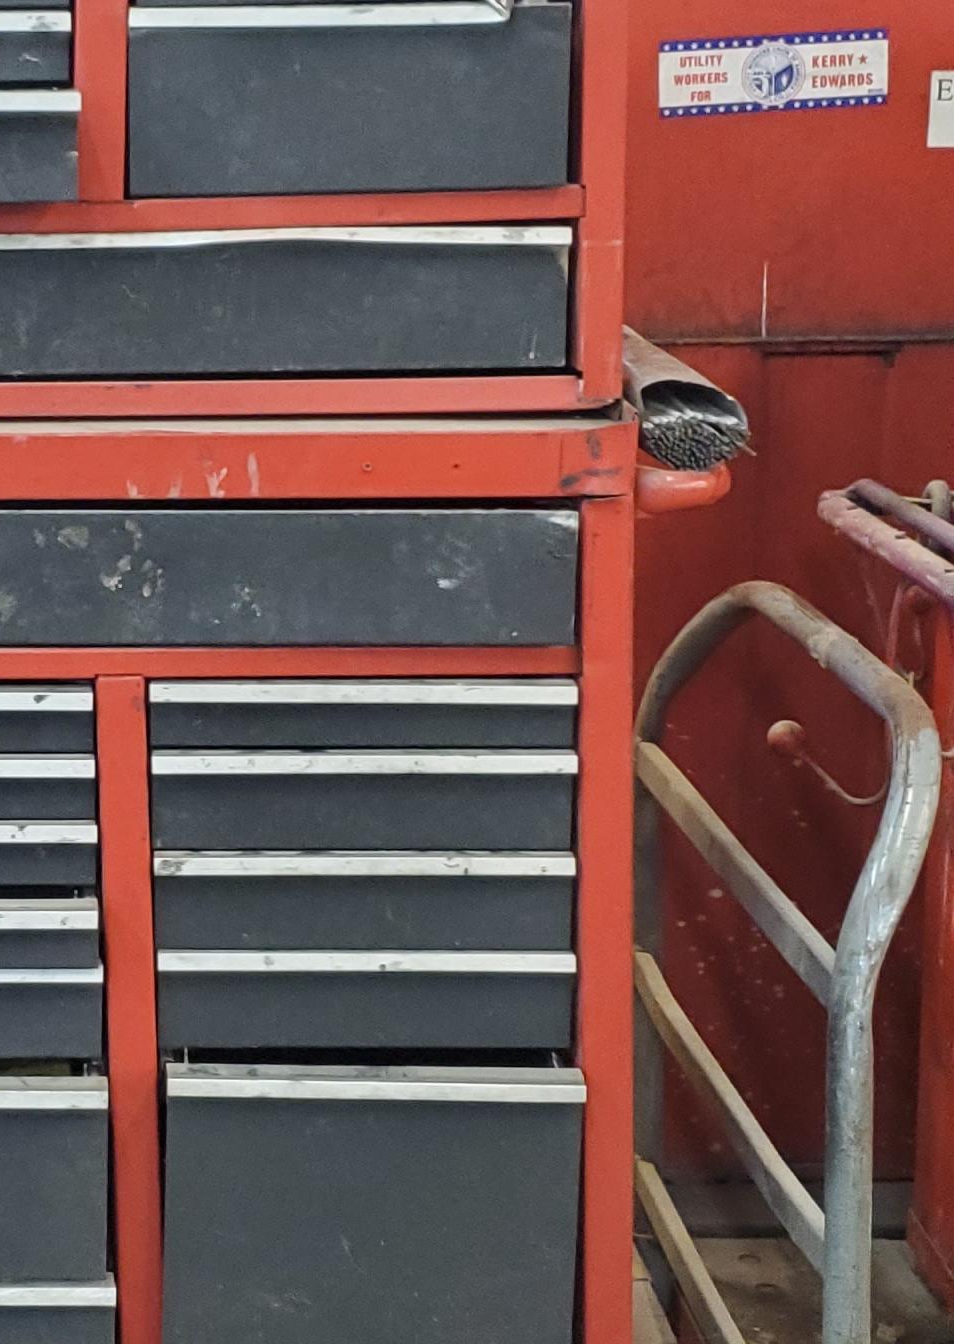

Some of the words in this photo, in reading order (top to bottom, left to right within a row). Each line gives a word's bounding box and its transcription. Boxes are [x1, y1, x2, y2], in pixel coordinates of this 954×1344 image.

[679, 54, 723, 69] UTILITY
[811, 53, 854, 68] KERRY
[673, 71, 729, 86] WORKERS
[811, 72, 874, 89] EDWARDS
[690, 90, 712, 103] FOR
